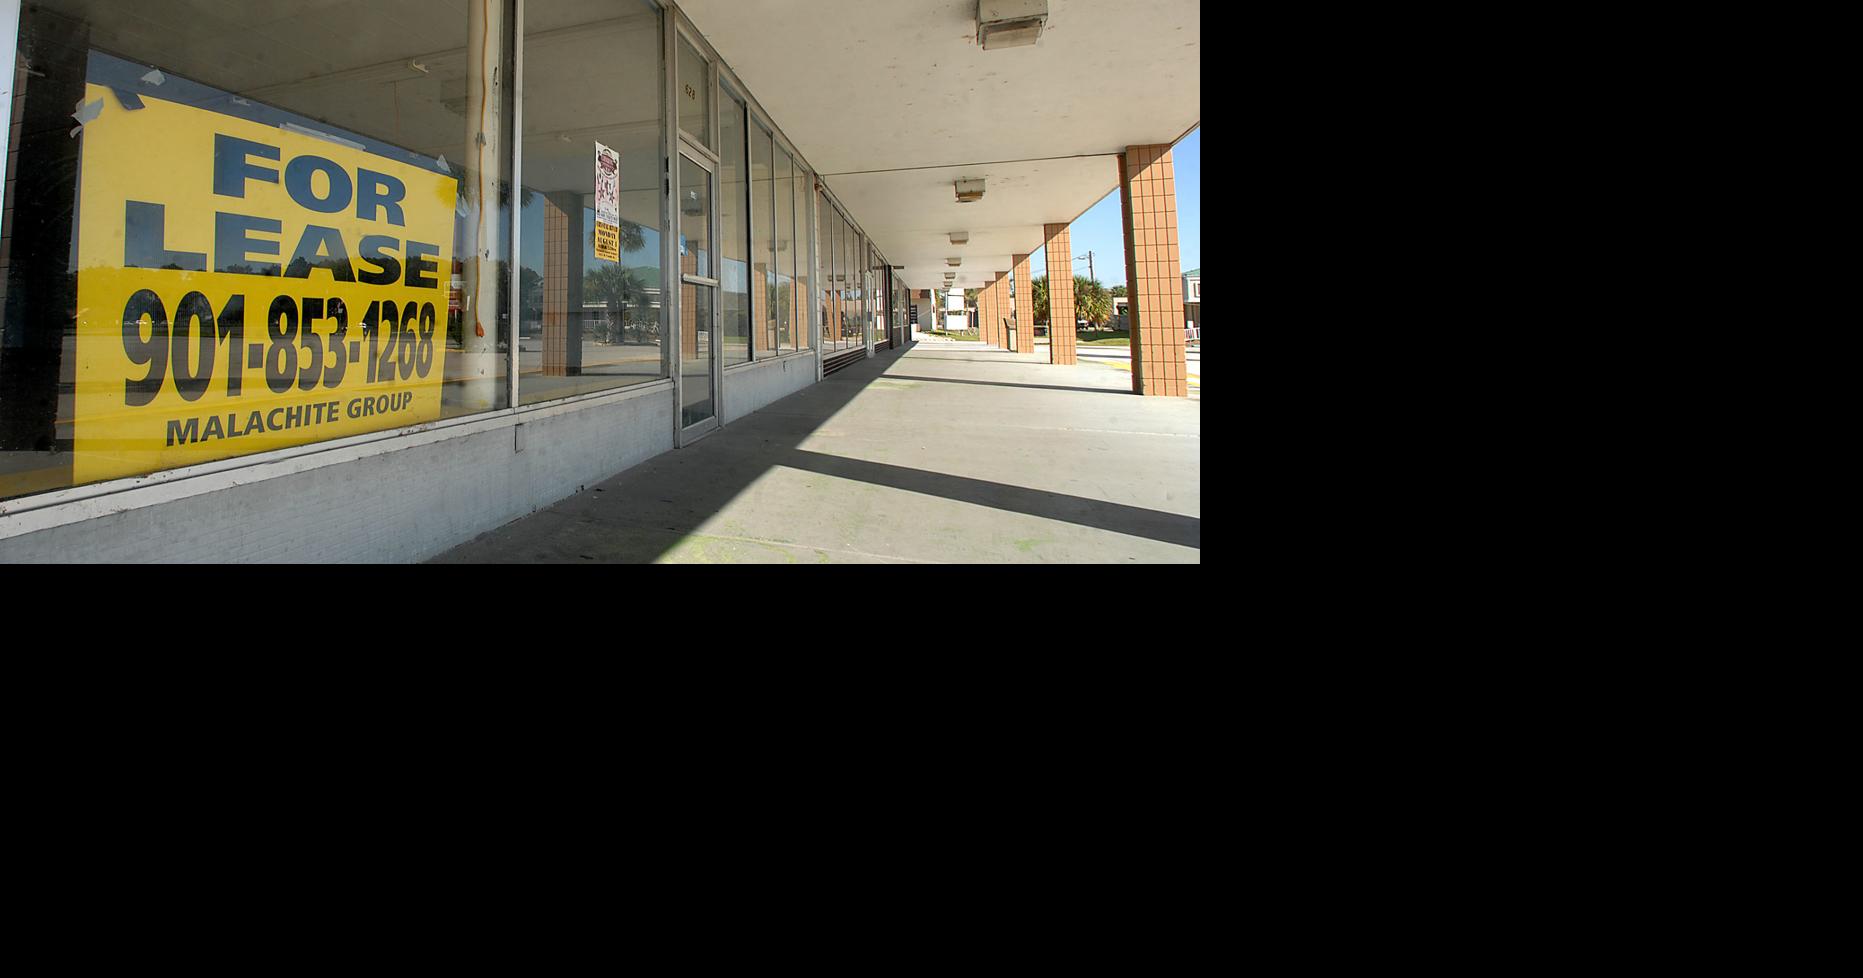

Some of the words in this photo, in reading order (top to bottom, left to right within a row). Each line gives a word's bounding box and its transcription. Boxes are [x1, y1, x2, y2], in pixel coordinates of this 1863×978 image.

[213, 133, 406, 227] FOR
[124, 199, 440, 289] LEASE
[121, 288, 436, 407] 901-853-1268
[166, 400, 339, 447] MALACHITE
[346, 391, 413, 418] GROUP
